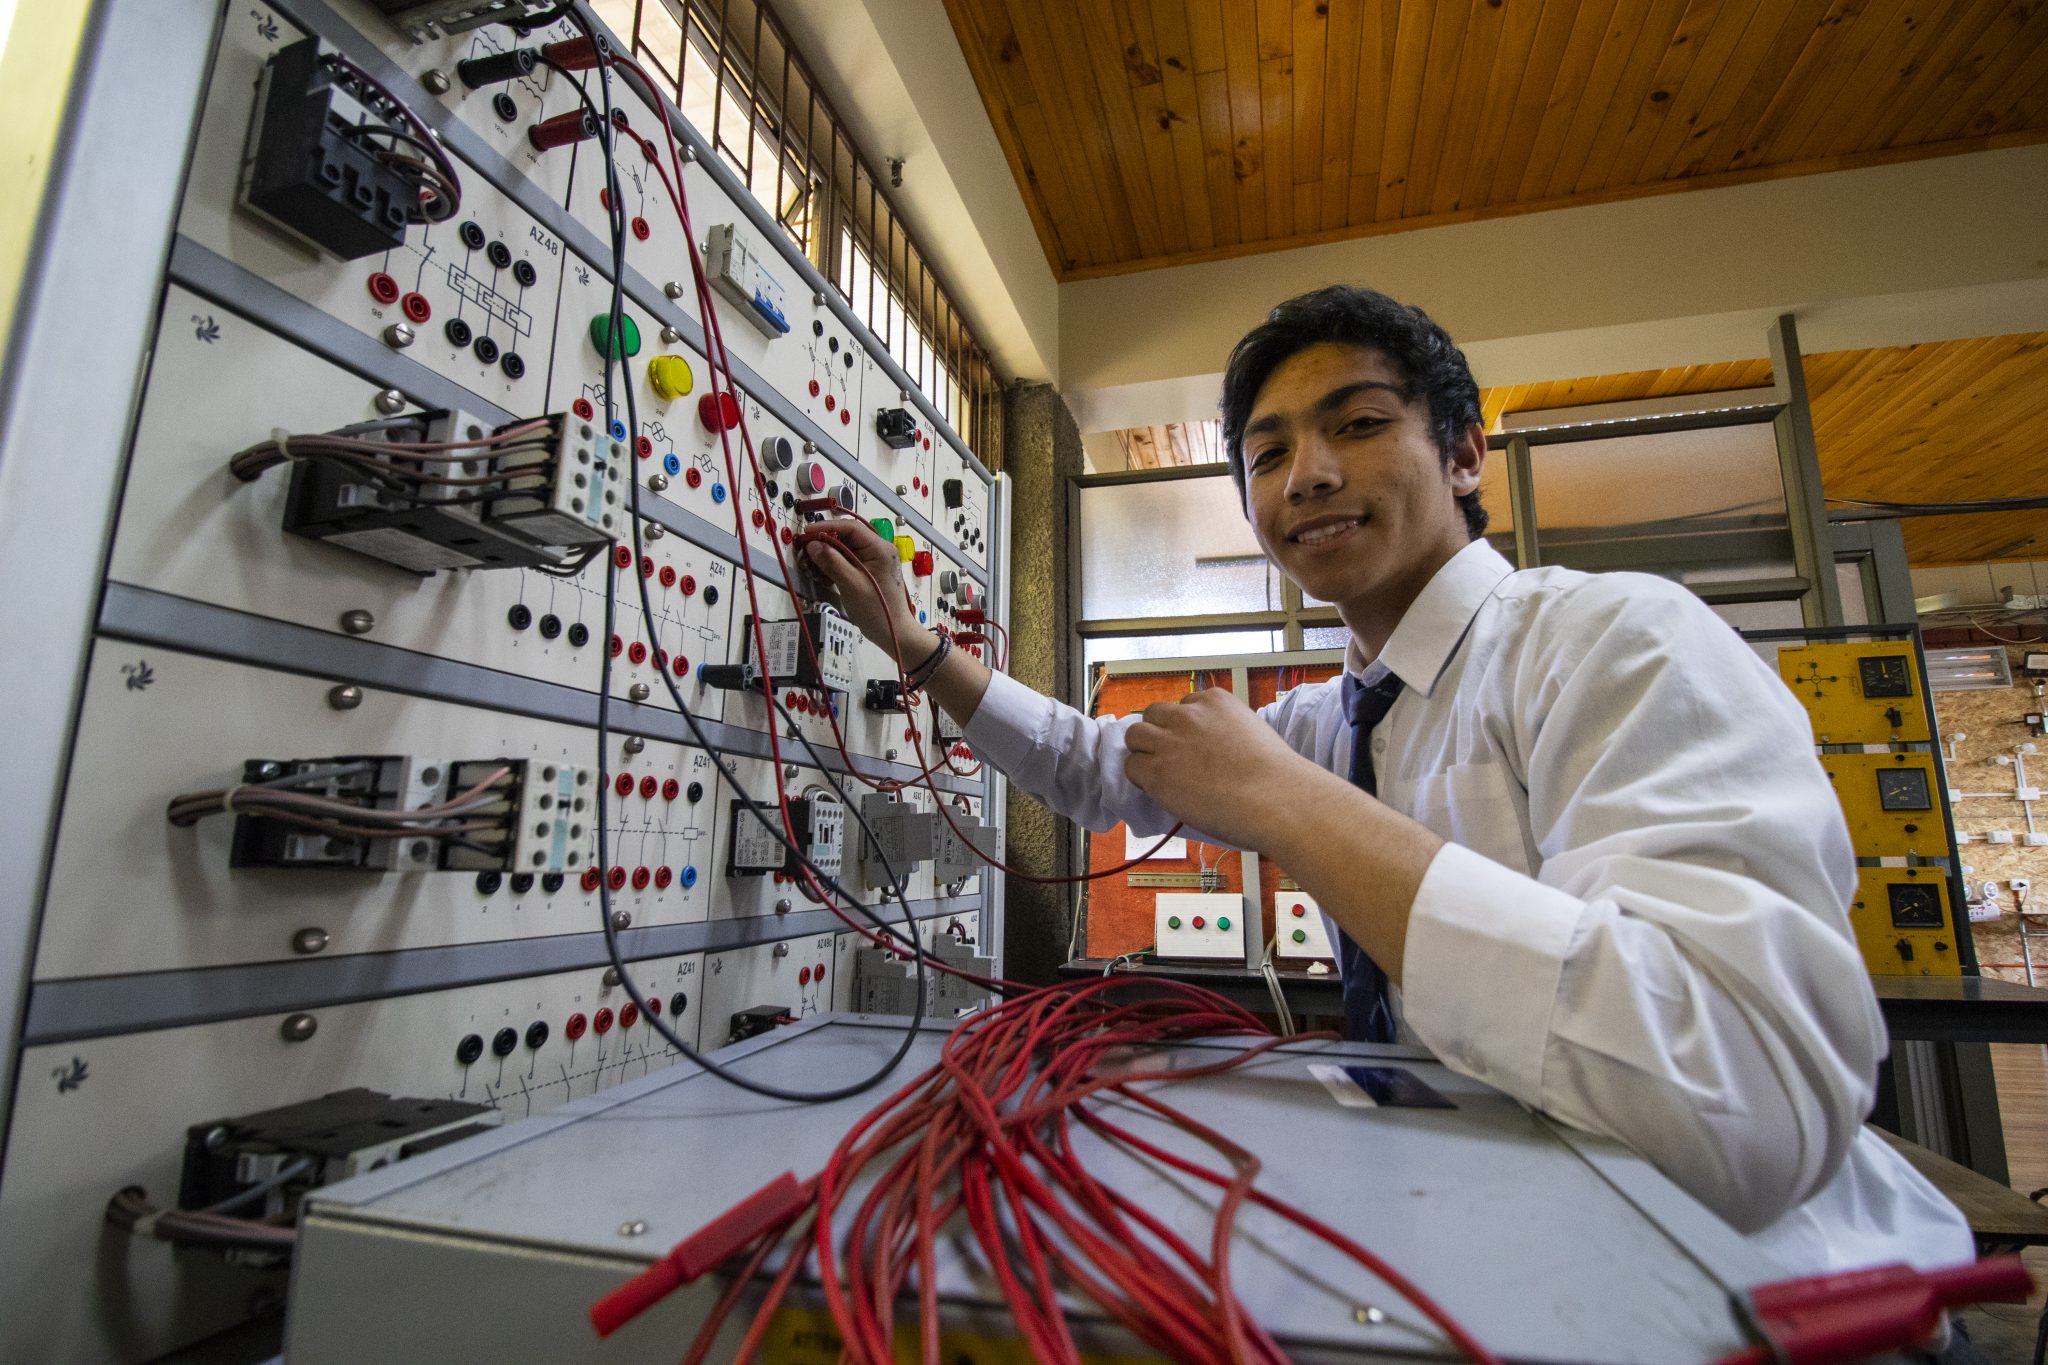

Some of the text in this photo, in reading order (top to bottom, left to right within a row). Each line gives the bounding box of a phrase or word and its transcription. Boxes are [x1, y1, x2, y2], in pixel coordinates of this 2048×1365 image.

[529, 225, 558, 256] AZ48
[371, 308, 383, 320] 98
[451, 353, 456, 362] 2
[506, 384, 512, 392] 6
[709, 560, 726, 577] AZ41
[693, 755, 711, 769] AZ41
[482, 905, 487, 914] 2
[677, 961, 696, 977] AZ41
[504, 1008, 509, 1016] 3
